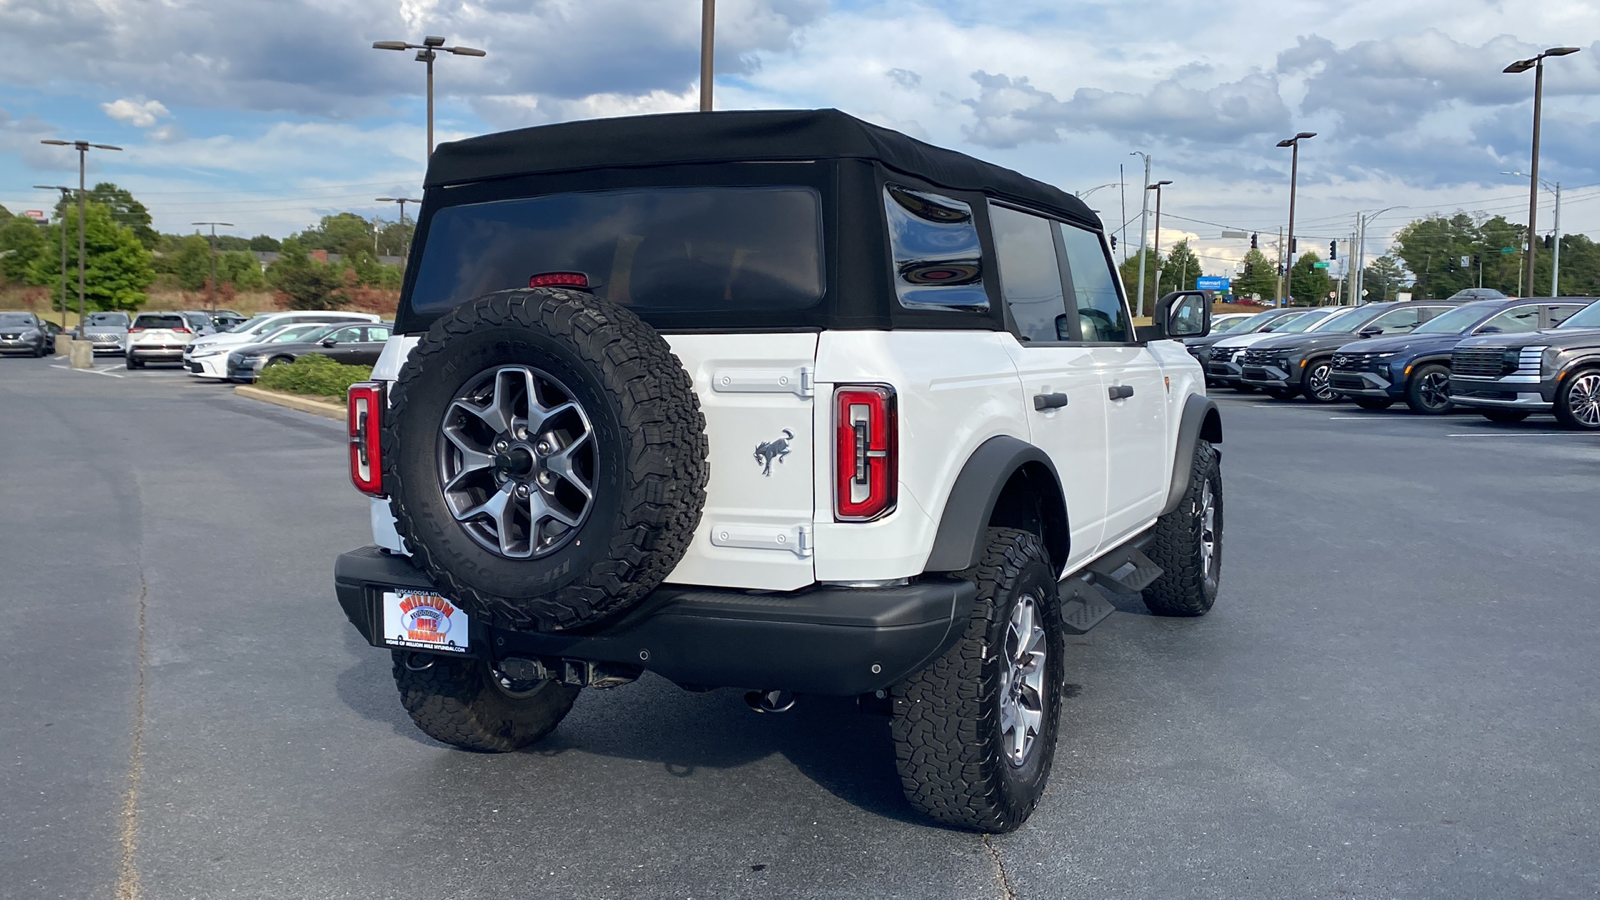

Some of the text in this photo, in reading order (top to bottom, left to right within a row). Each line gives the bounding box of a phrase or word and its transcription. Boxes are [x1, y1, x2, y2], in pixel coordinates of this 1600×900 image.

[399, 595, 454, 618] MILLION
[416, 617, 437, 631] MILE
[408, 629, 447, 642] WARRANTY
